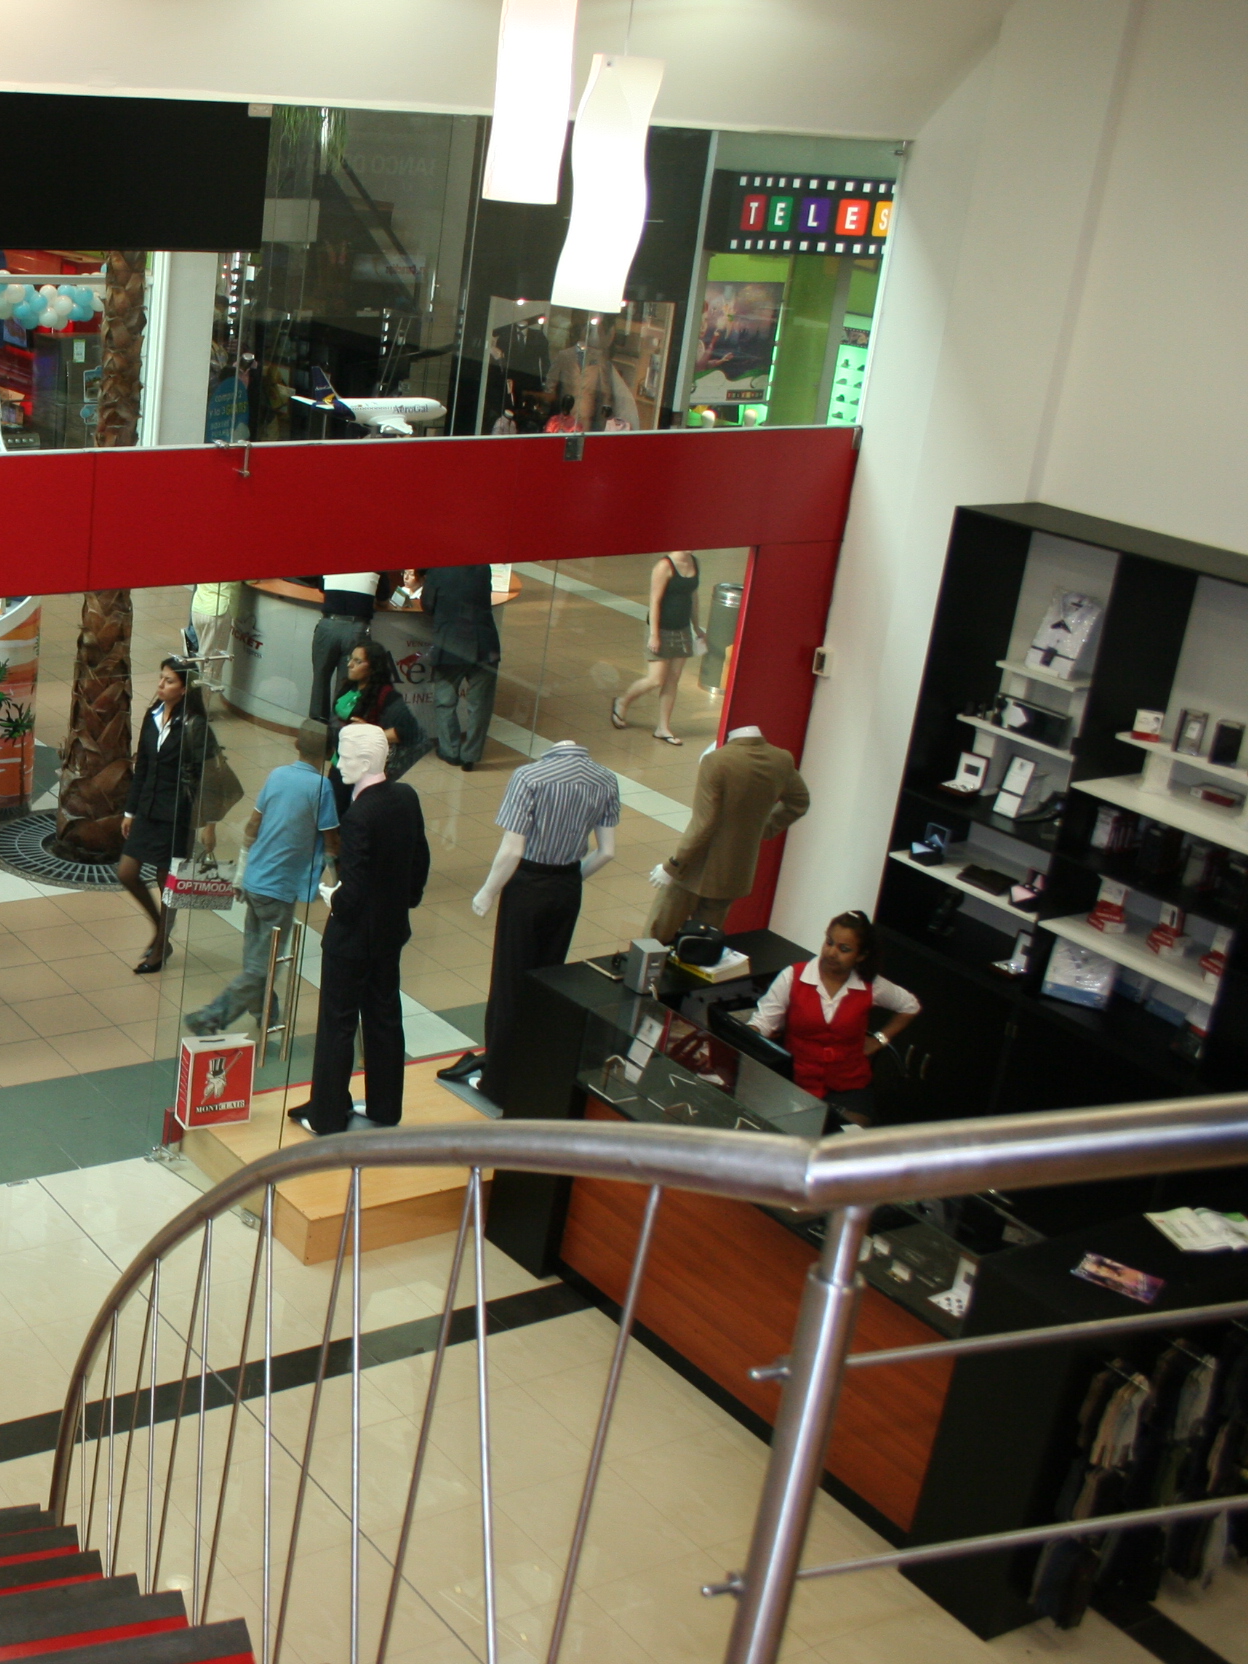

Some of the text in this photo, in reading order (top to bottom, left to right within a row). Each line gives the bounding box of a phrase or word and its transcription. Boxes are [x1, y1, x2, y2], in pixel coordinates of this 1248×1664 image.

[749, 202, 892, 231] TELES
[176, 881, 233, 892] OPTIMODA
[196, 1100, 246, 1113] MONTCLAIR
